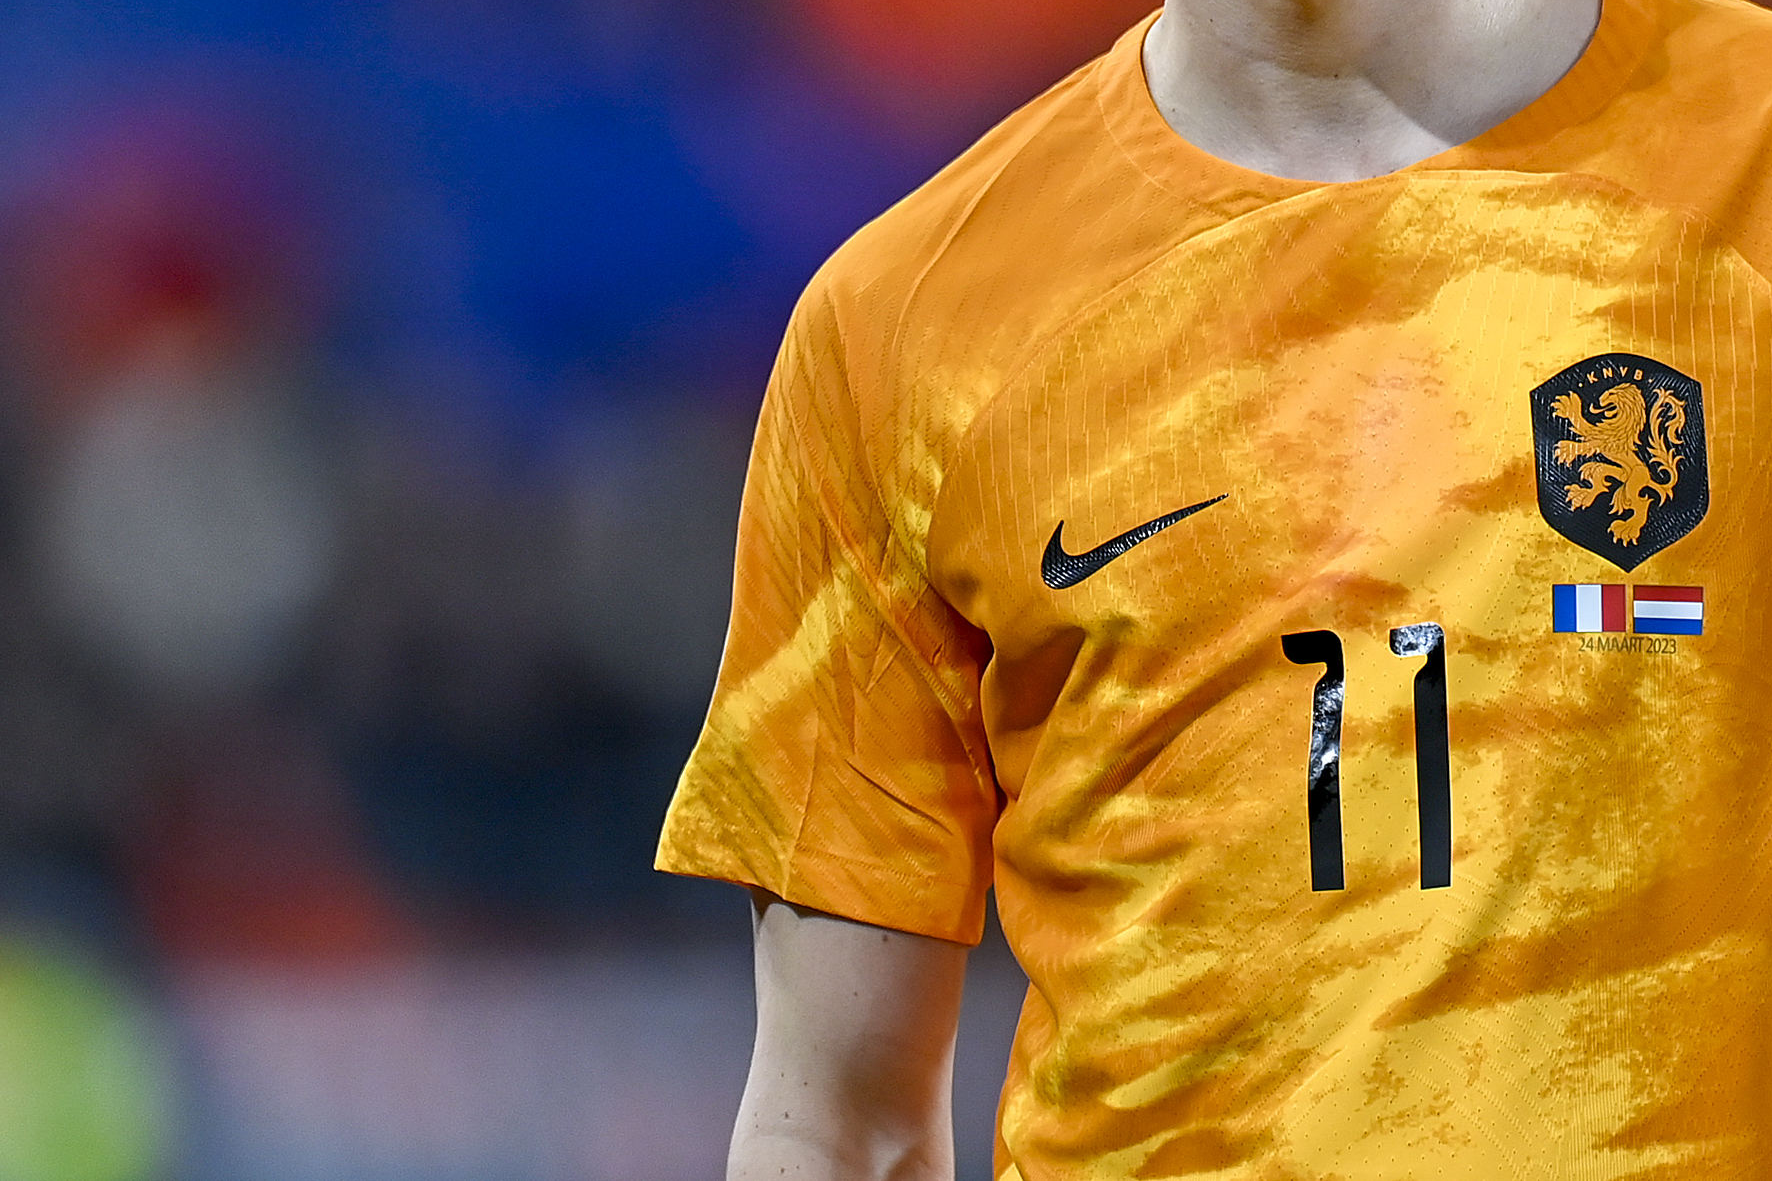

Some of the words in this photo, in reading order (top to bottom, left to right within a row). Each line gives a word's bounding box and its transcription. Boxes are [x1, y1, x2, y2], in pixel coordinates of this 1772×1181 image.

[1586, 366, 1644, 384] KNVB
[1578, 637, 1594, 652] 24
[1597, 636, 1644, 653] MAART
[1646, 638, 1677, 654] 2023
[1281, 622, 1452, 892] 11
